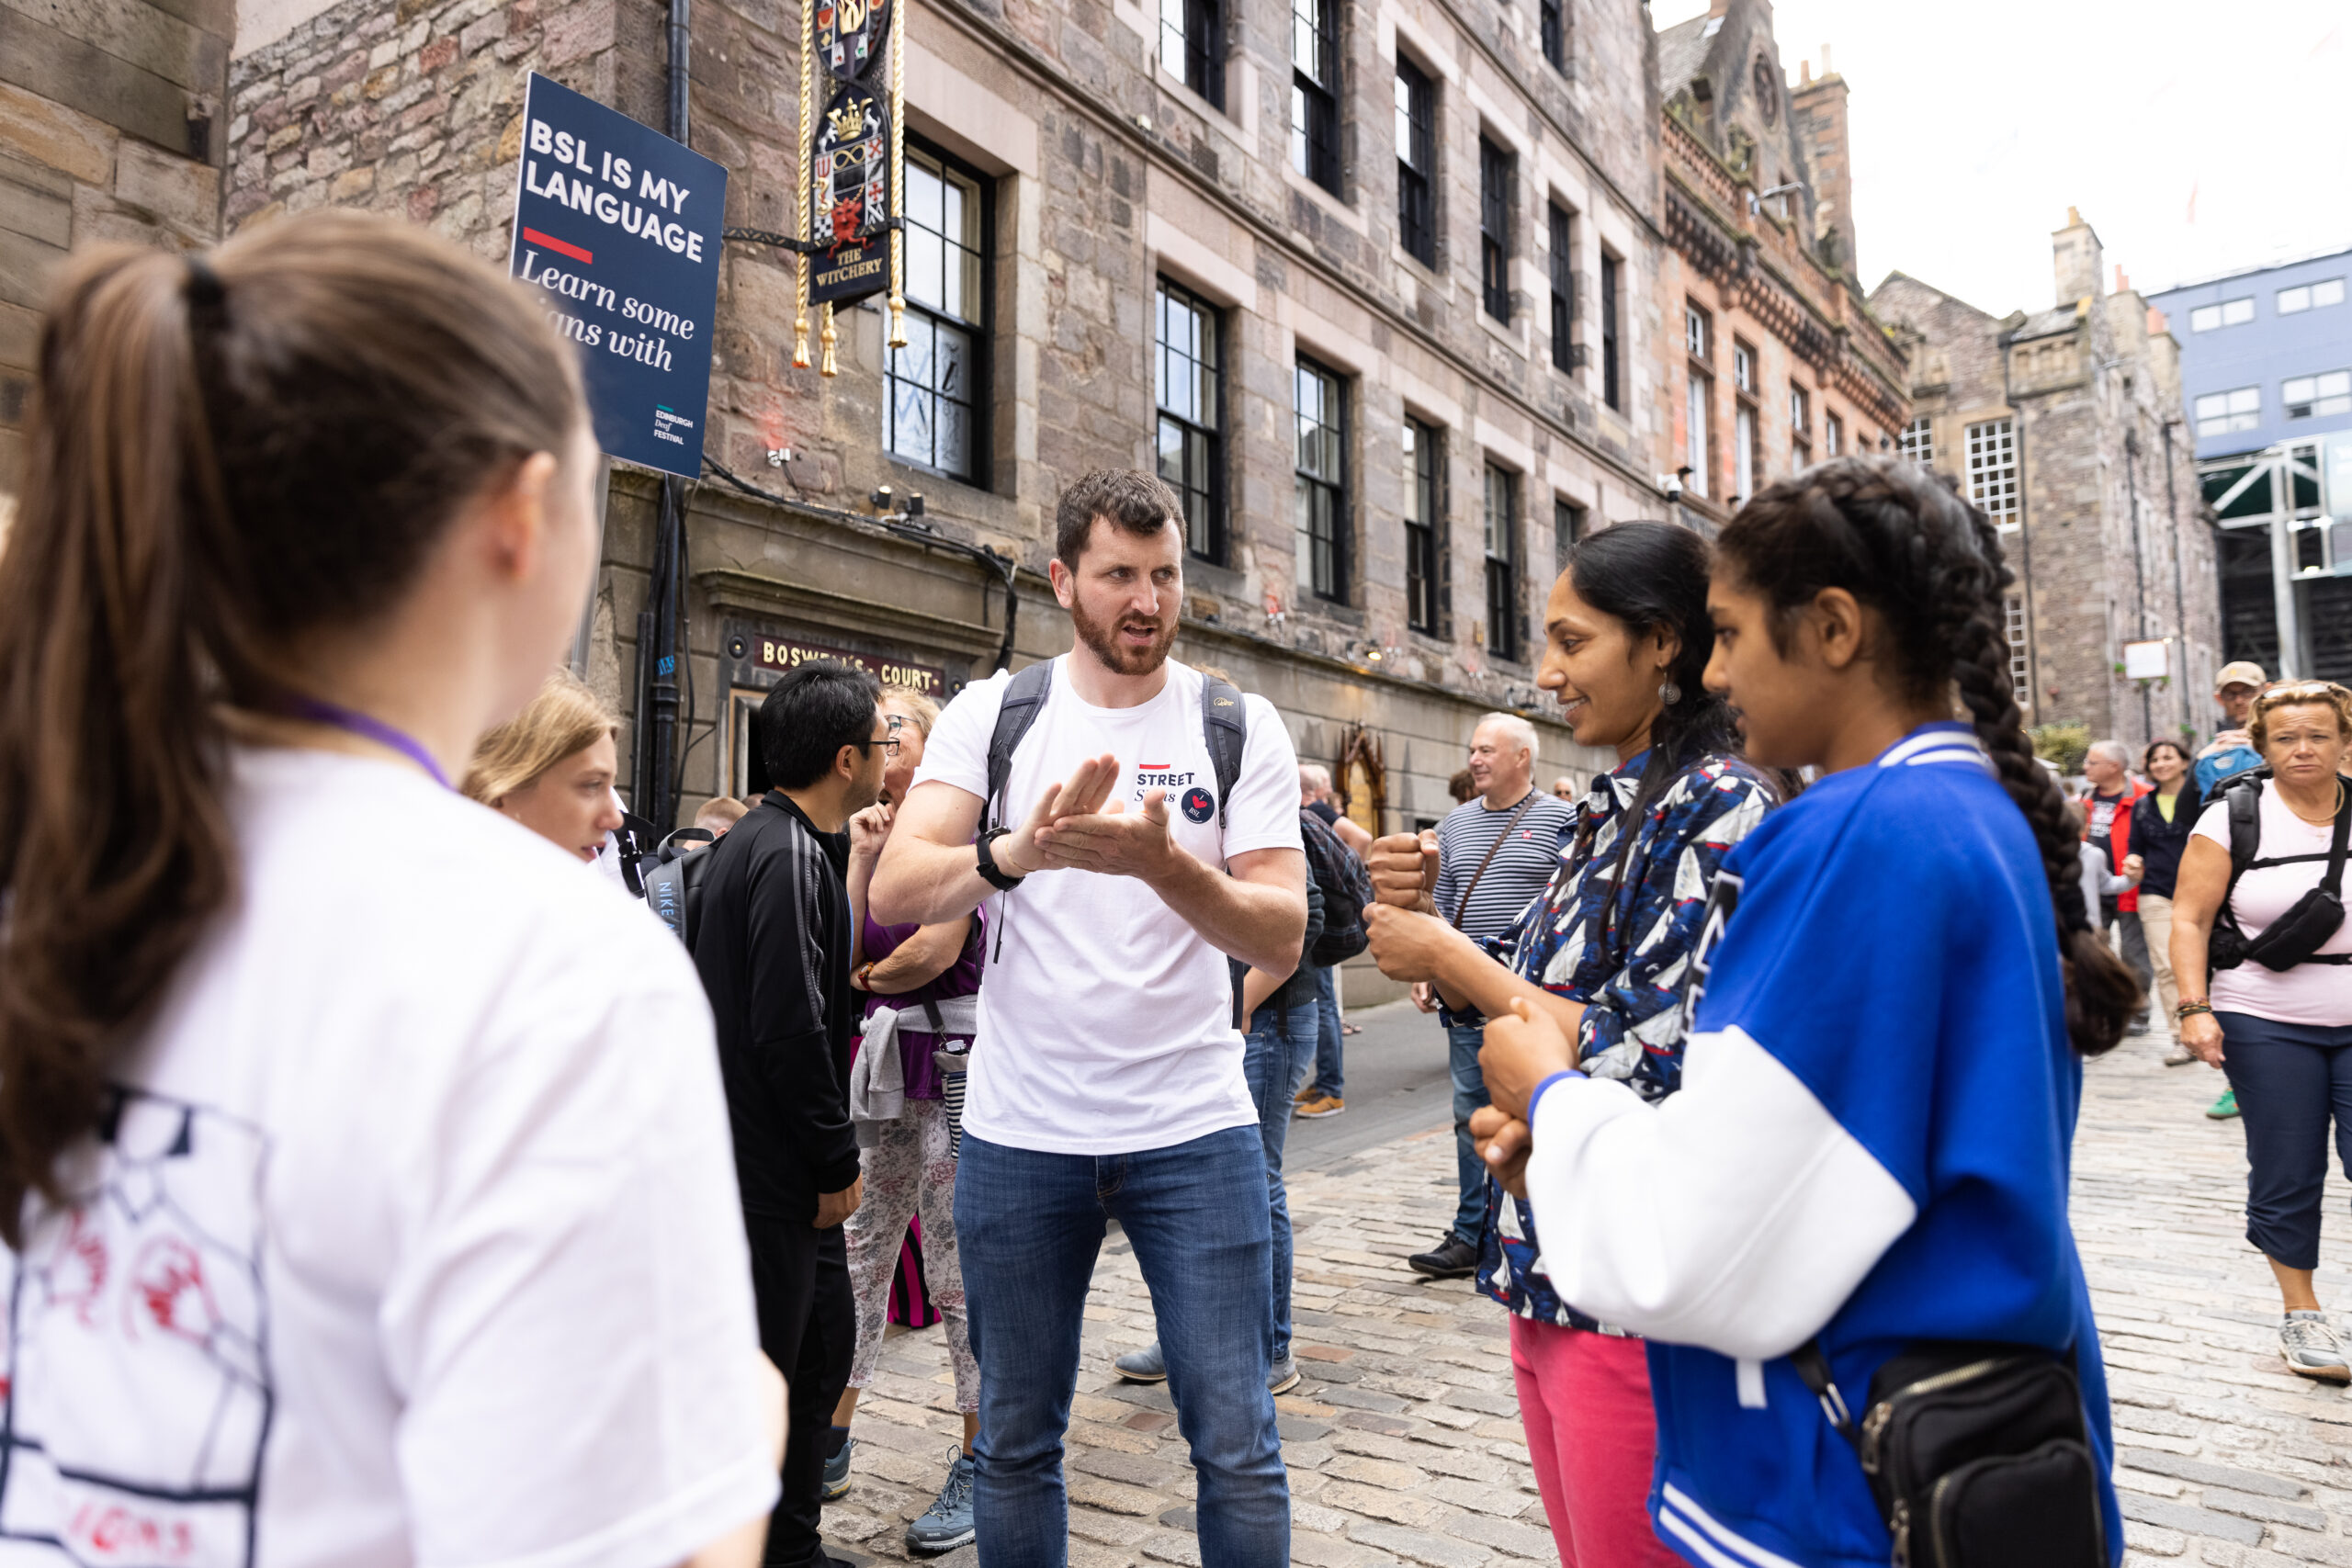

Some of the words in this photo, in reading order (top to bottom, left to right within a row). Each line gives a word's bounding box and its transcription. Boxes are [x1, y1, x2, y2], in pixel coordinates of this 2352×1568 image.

[530, 118, 593, 175] BSL
[602, 151, 631, 189] IS
[639, 170, 690, 215] MY
[526, 160, 704, 264] LANGUAGE
[837, 248, 862, 266] THE
[816, 258, 883, 287] WITCHERY
[520, 249, 616, 311] Learn
[622, 297, 695, 340] some
[608, 331, 673, 372] with
[656, 410, 693, 428] EDINBURGH
[654, 429, 684, 445] FESTIVAL
[881, 664, 933, 690] COURT
[1136, 773, 1195, 786] STREET
[659, 881, 675, 917] NIKE
